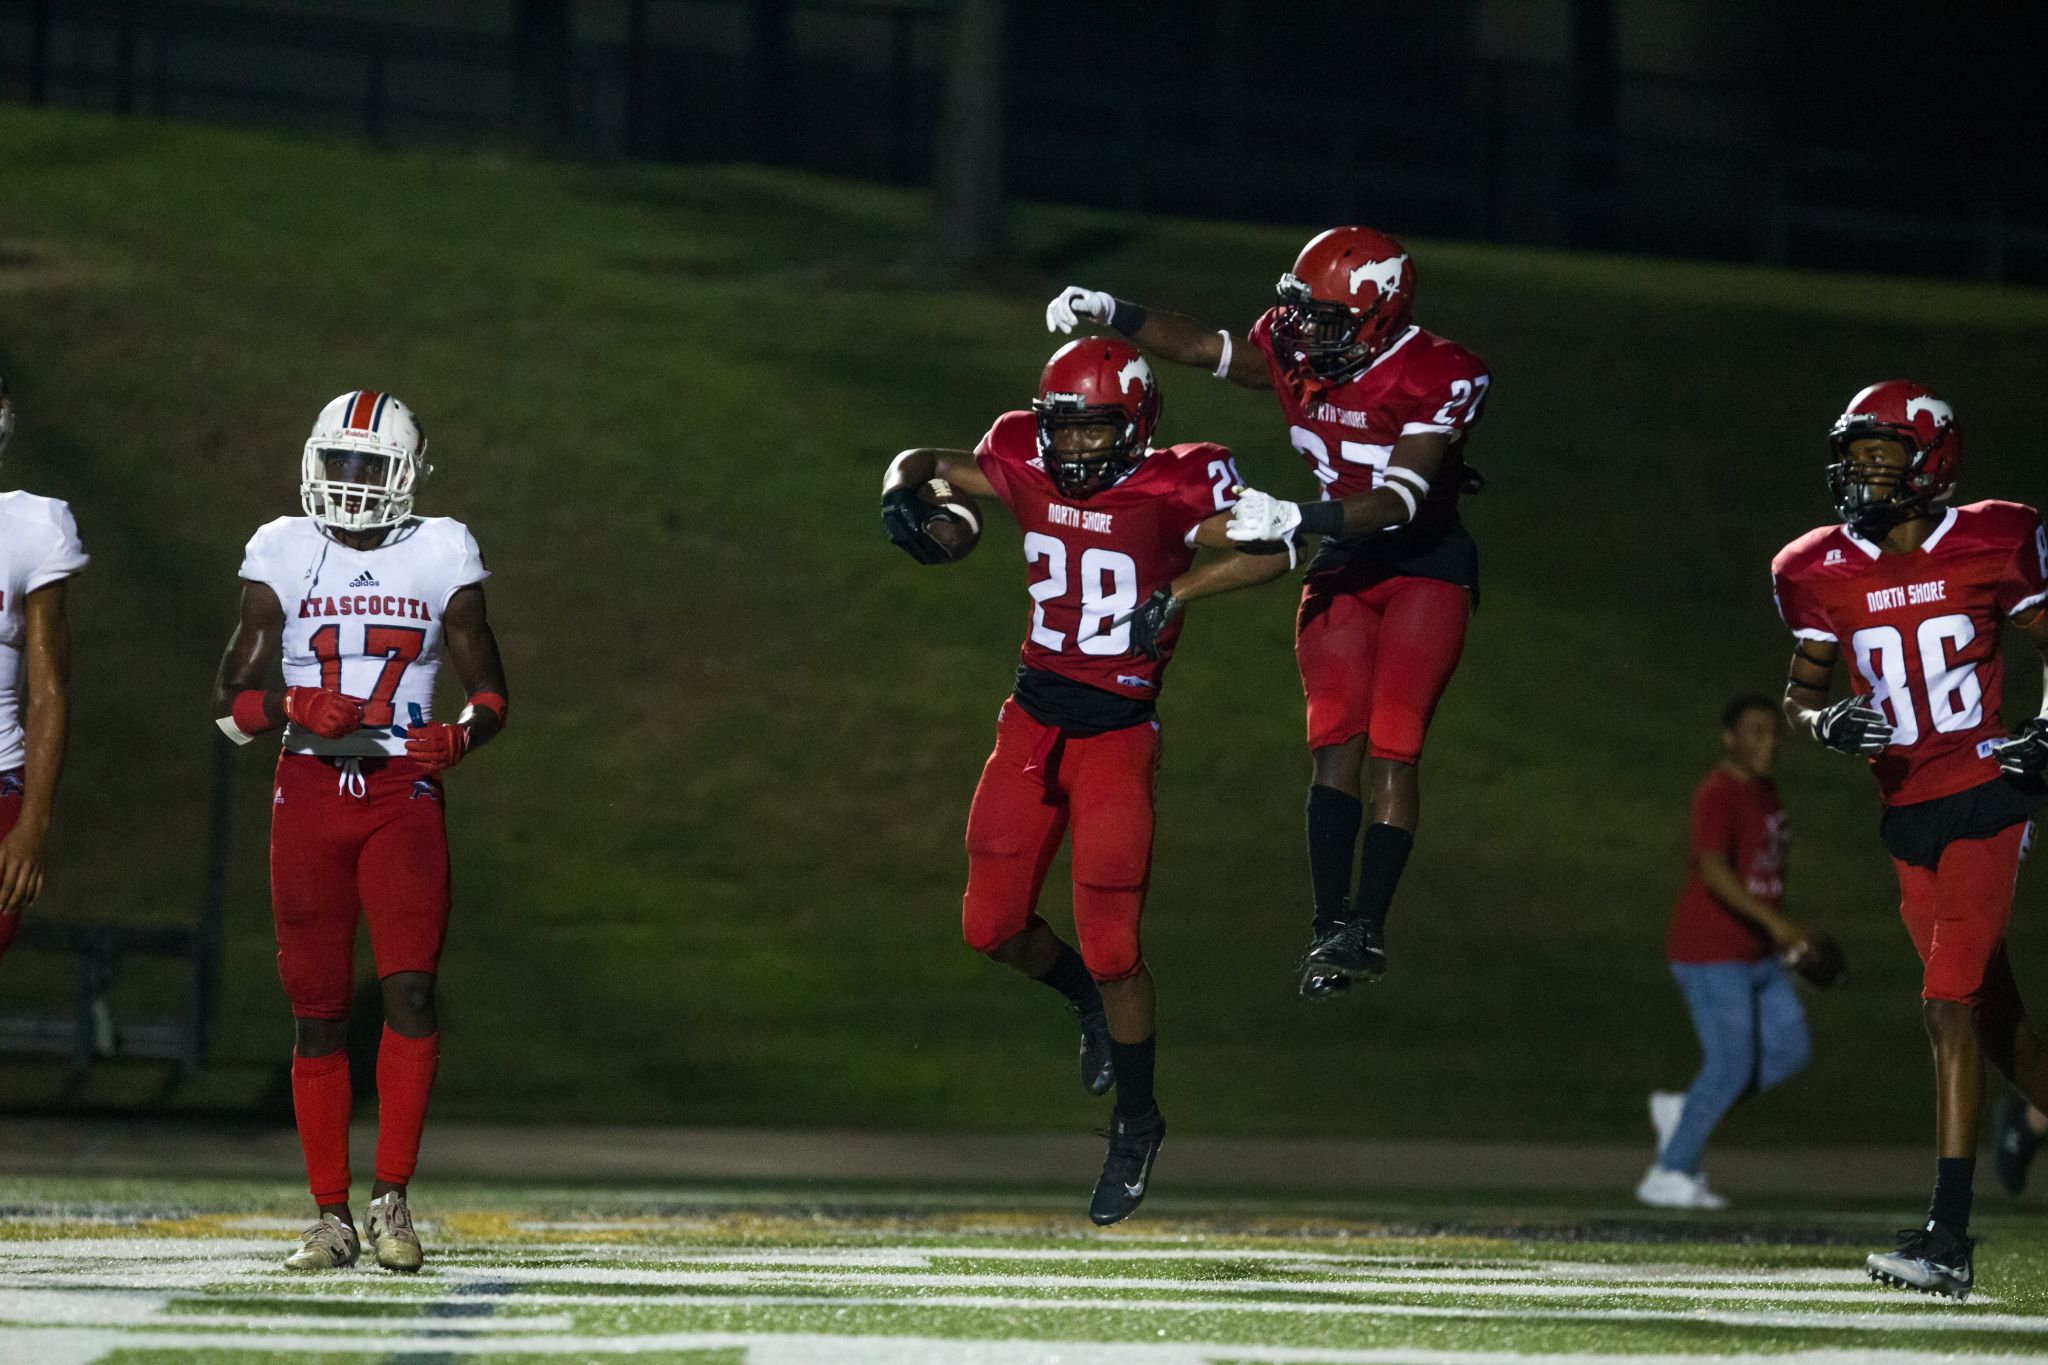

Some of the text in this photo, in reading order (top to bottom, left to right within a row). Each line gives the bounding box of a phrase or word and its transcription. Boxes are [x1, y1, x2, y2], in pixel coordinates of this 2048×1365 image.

[1432, 375, 1489, 425] 27
[345, 429, 369, 439] Riddell
[1048, 503, 1113, 534] NORTH SHORE
[350, 579, 380, 588] adidas
[1023, 531, 1138, 655] 28
[1866, 580, 1946, 613] NORTH SHORE
[298, 595, 432, 621] ATASCOCITA
[309, 623, 427, 729] 17
[1852, 613, 1983, 746] 86
